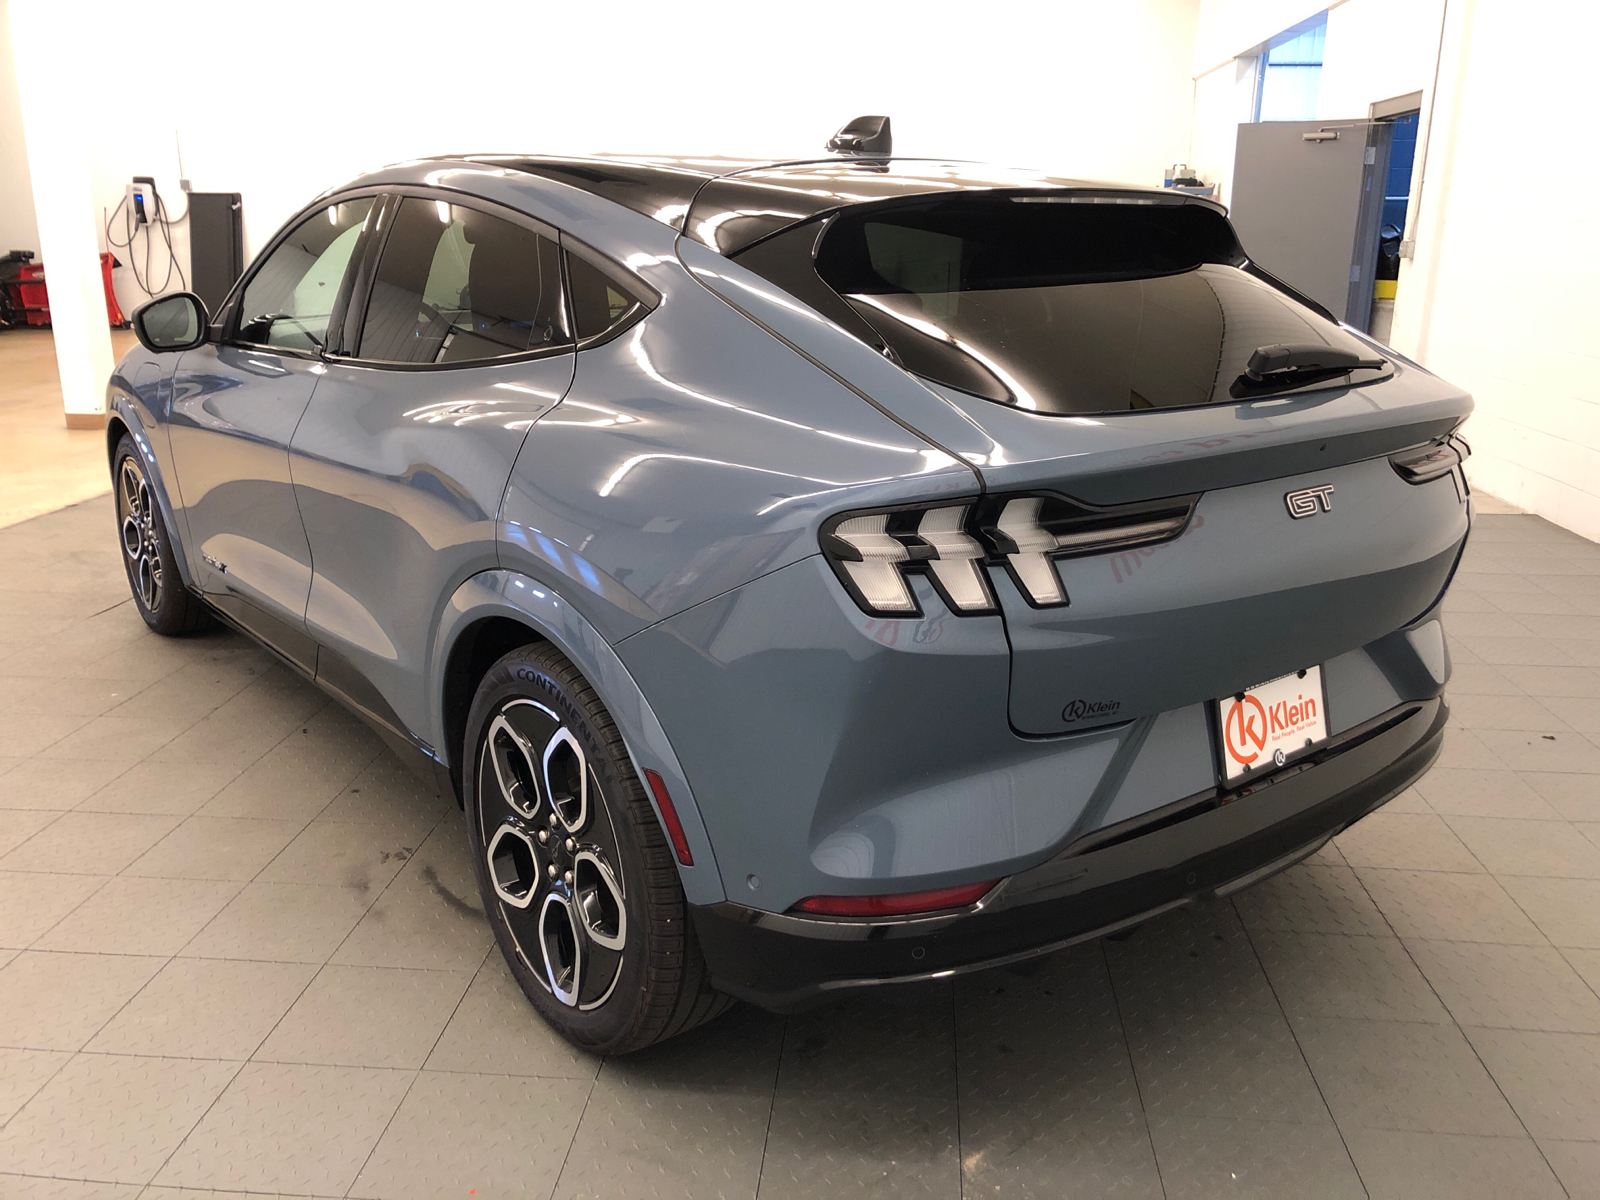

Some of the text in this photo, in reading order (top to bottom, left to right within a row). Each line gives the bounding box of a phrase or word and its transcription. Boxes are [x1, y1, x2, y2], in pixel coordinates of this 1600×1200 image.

[1283, 484, 1334, 520] GT
[517, 668, 613, 784] CONTINENTAL
[1087, 700, 1120, 714] Klein
[1268, 694, 1317, 734] Klein
